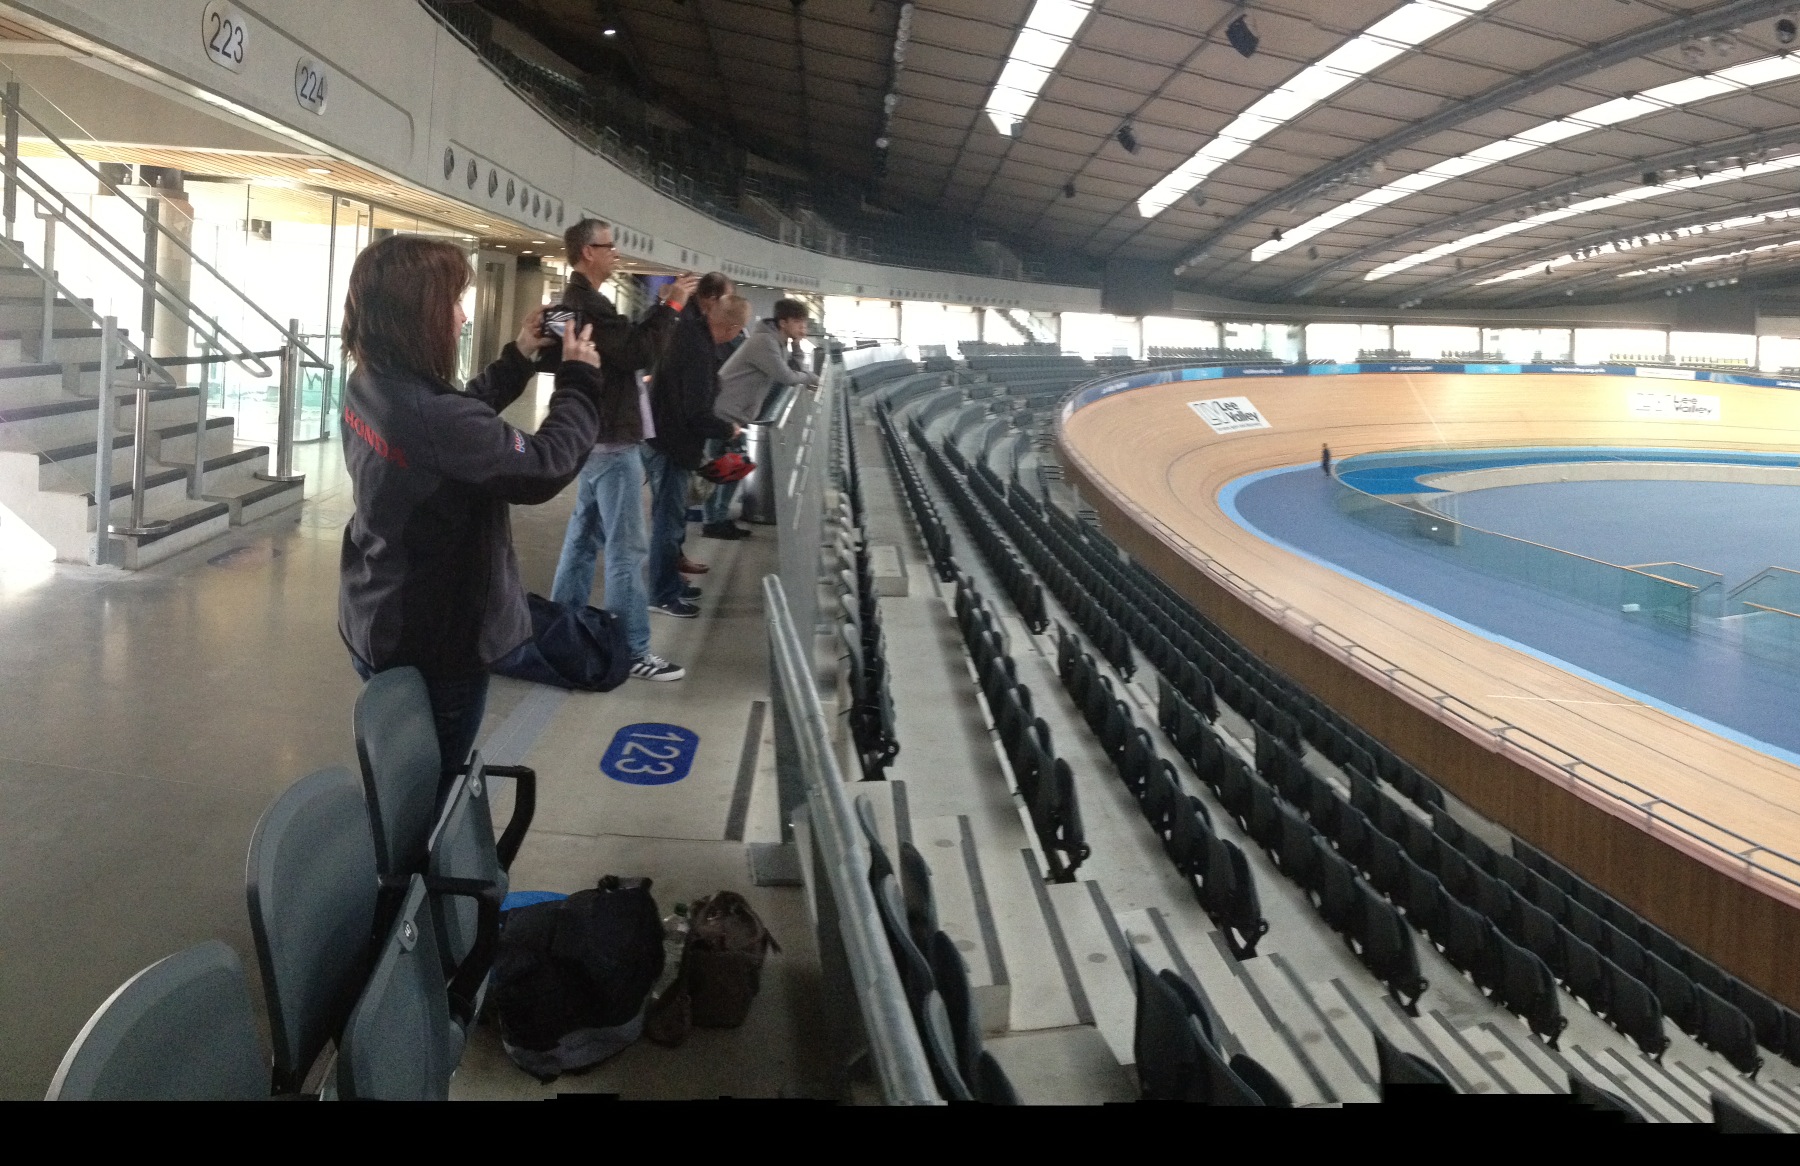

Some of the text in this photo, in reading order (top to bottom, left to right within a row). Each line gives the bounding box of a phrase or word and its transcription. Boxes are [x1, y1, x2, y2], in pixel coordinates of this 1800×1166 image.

[209, 11, 244, 64] 223
[300, 66, 324, 107] 224
[344, 406, 410, 468] HONDA
[614, 732, 686, 775] 123
